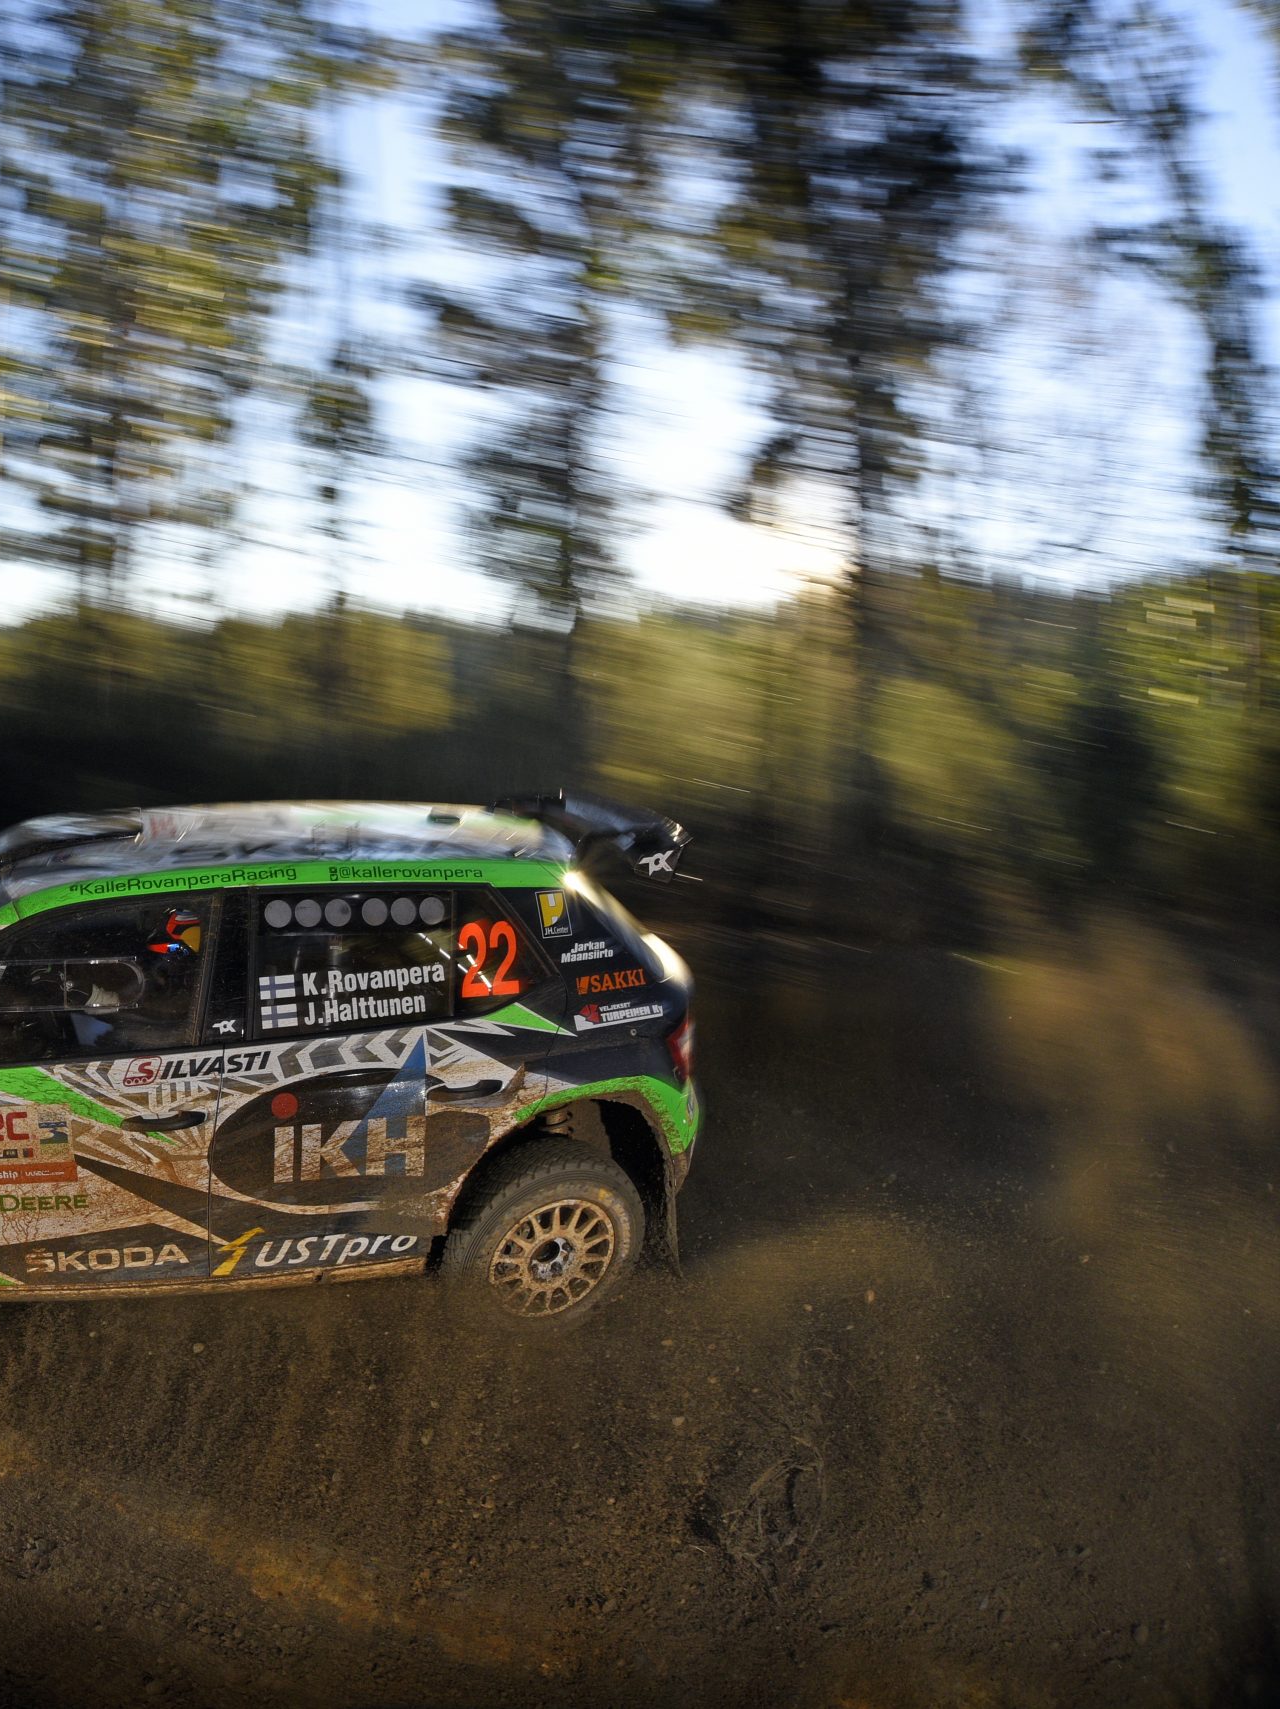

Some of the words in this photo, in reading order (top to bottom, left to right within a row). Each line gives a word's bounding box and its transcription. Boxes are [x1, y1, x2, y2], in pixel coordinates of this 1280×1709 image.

[339, 865, 483, 881] @kallerovanpera
[571, 941, 605, 954] Jarkan
[458, 920, 520, 998] 22
[561, 949, 614, 963] Maansiirto
[591, 968, 647, 993] SAKKI
[601, 1006, 651, 1022] TURPEINEN
